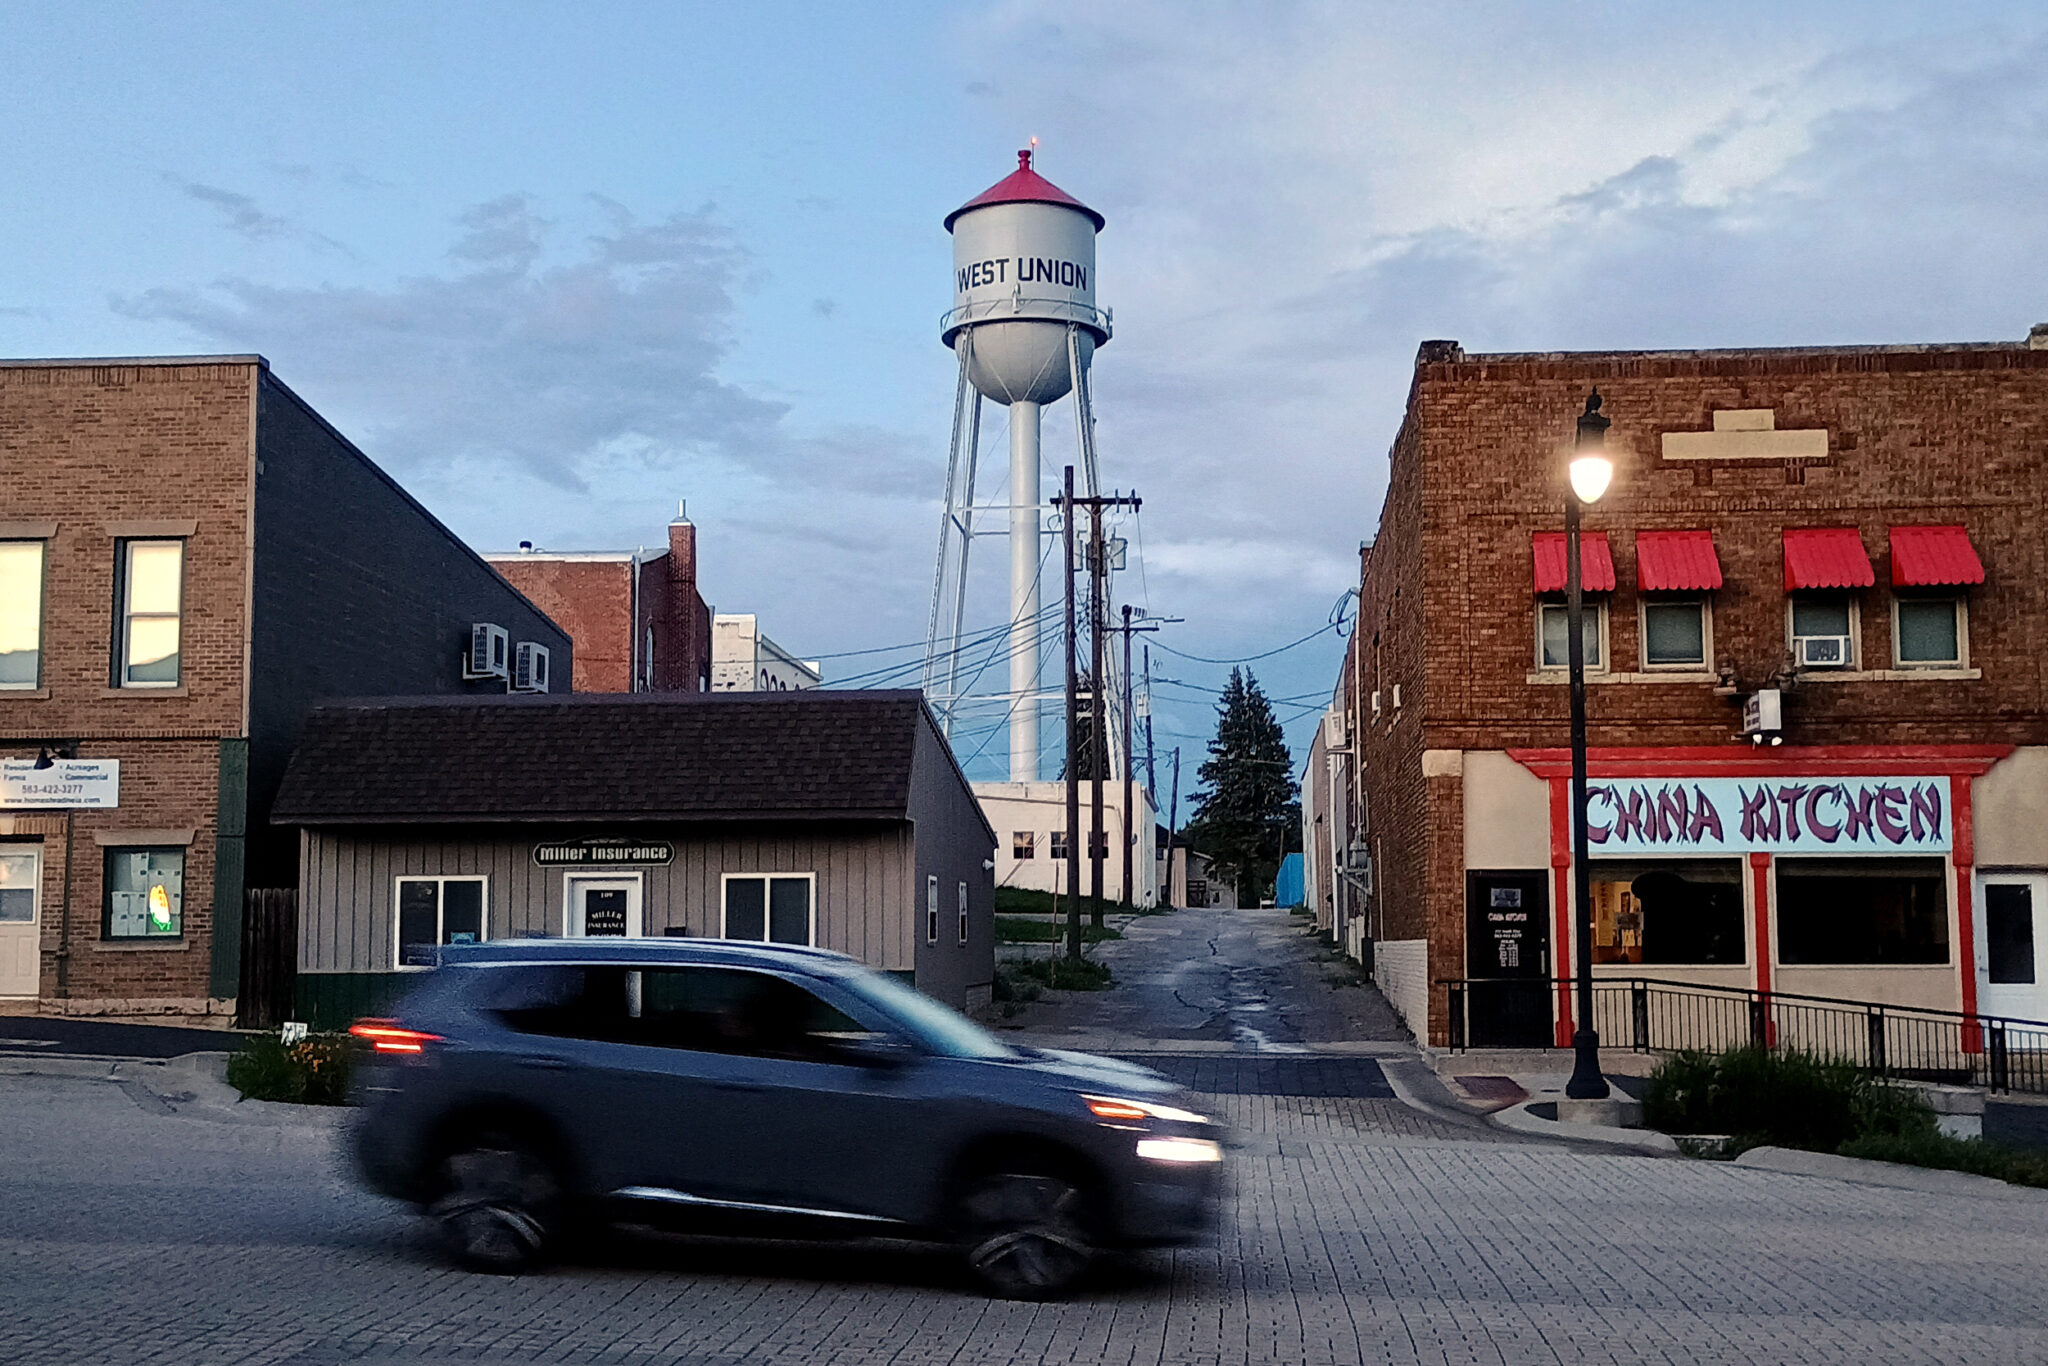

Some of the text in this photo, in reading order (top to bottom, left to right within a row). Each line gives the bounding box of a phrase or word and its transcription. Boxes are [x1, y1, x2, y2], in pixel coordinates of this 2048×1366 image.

[957, 257, 1087, 294] WEST UNION
[64, 773, 109, 781] Commercial
[1586, 781, 1945, 846] CHINA KITCHEN
[540, 846, 668, 861] Miller Insurance
[591, 910, 623, 920] MILLER
